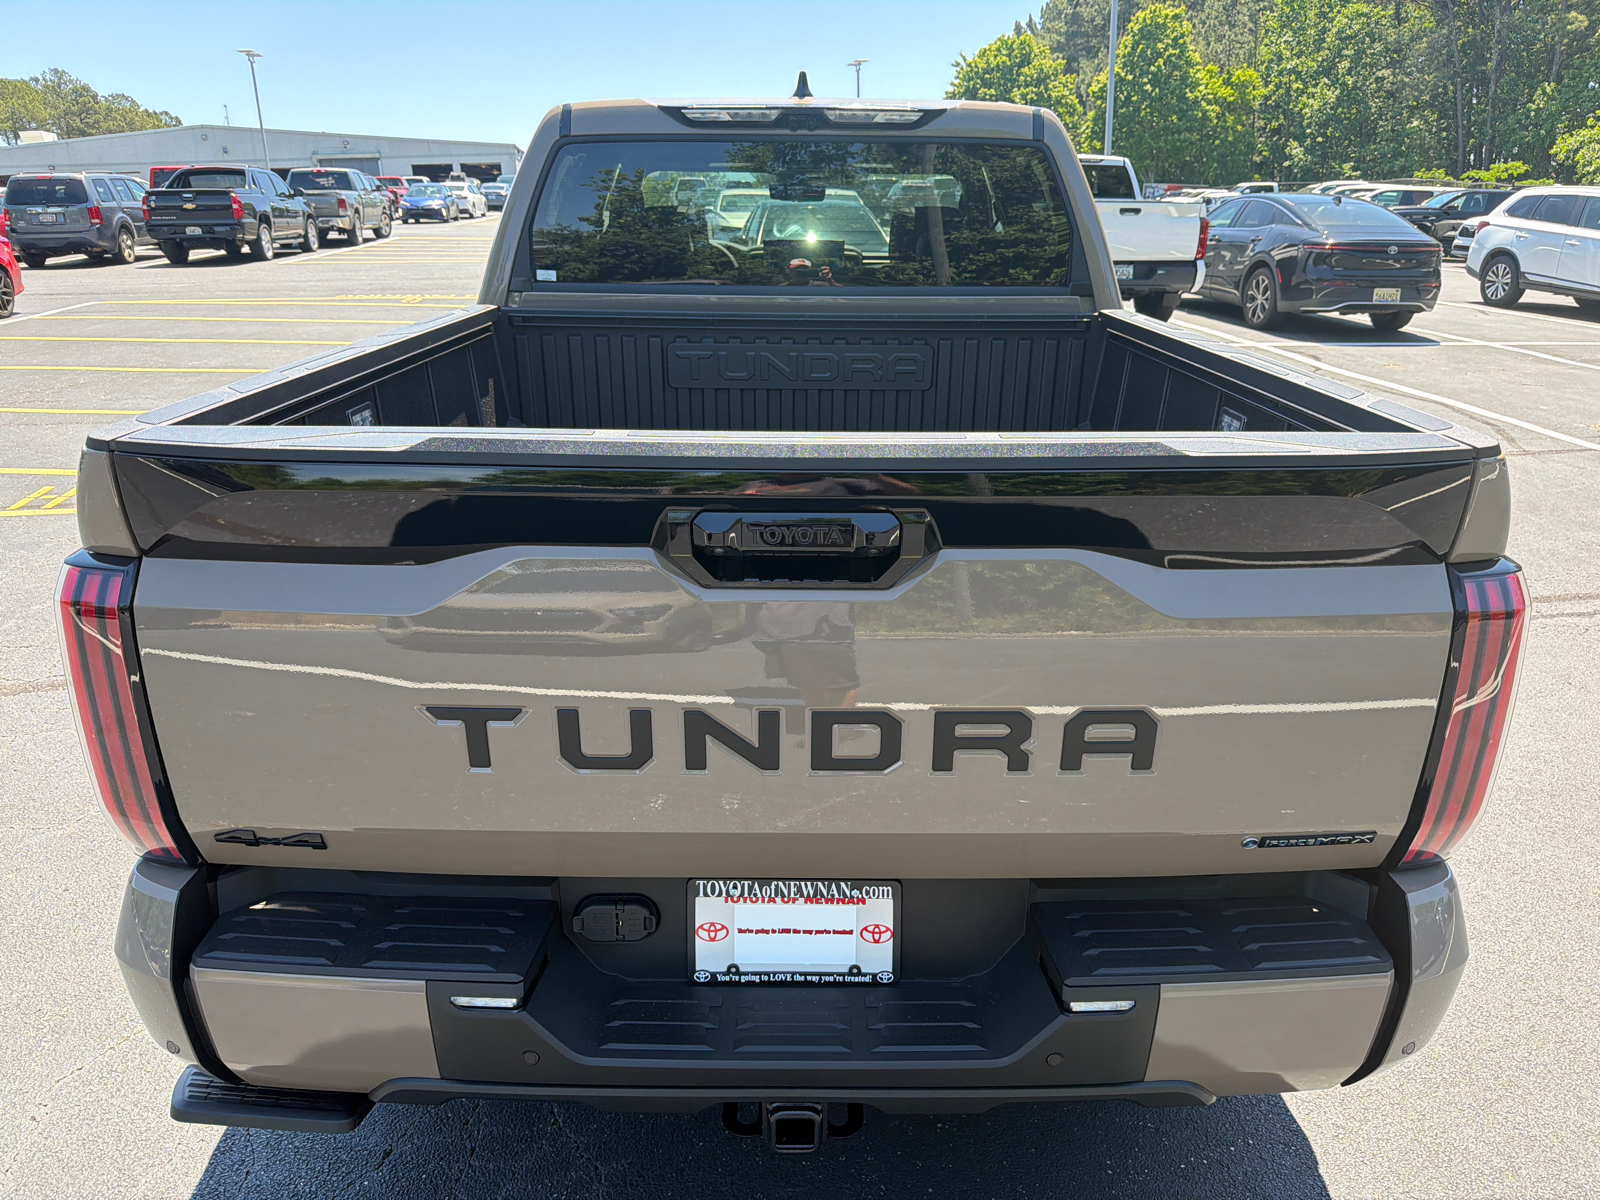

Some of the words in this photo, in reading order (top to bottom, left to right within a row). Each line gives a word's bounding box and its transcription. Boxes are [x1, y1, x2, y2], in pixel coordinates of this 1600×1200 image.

[675, 351, 925, 383] TUNDRA
[749, 525, 844, 545] TOYOTA
[417, 704, 1160, 775] TUNDRA
[740, 974, 760, 983] going
[806, 975, 820, 983] way
[821, 974, 843, 983] you're
